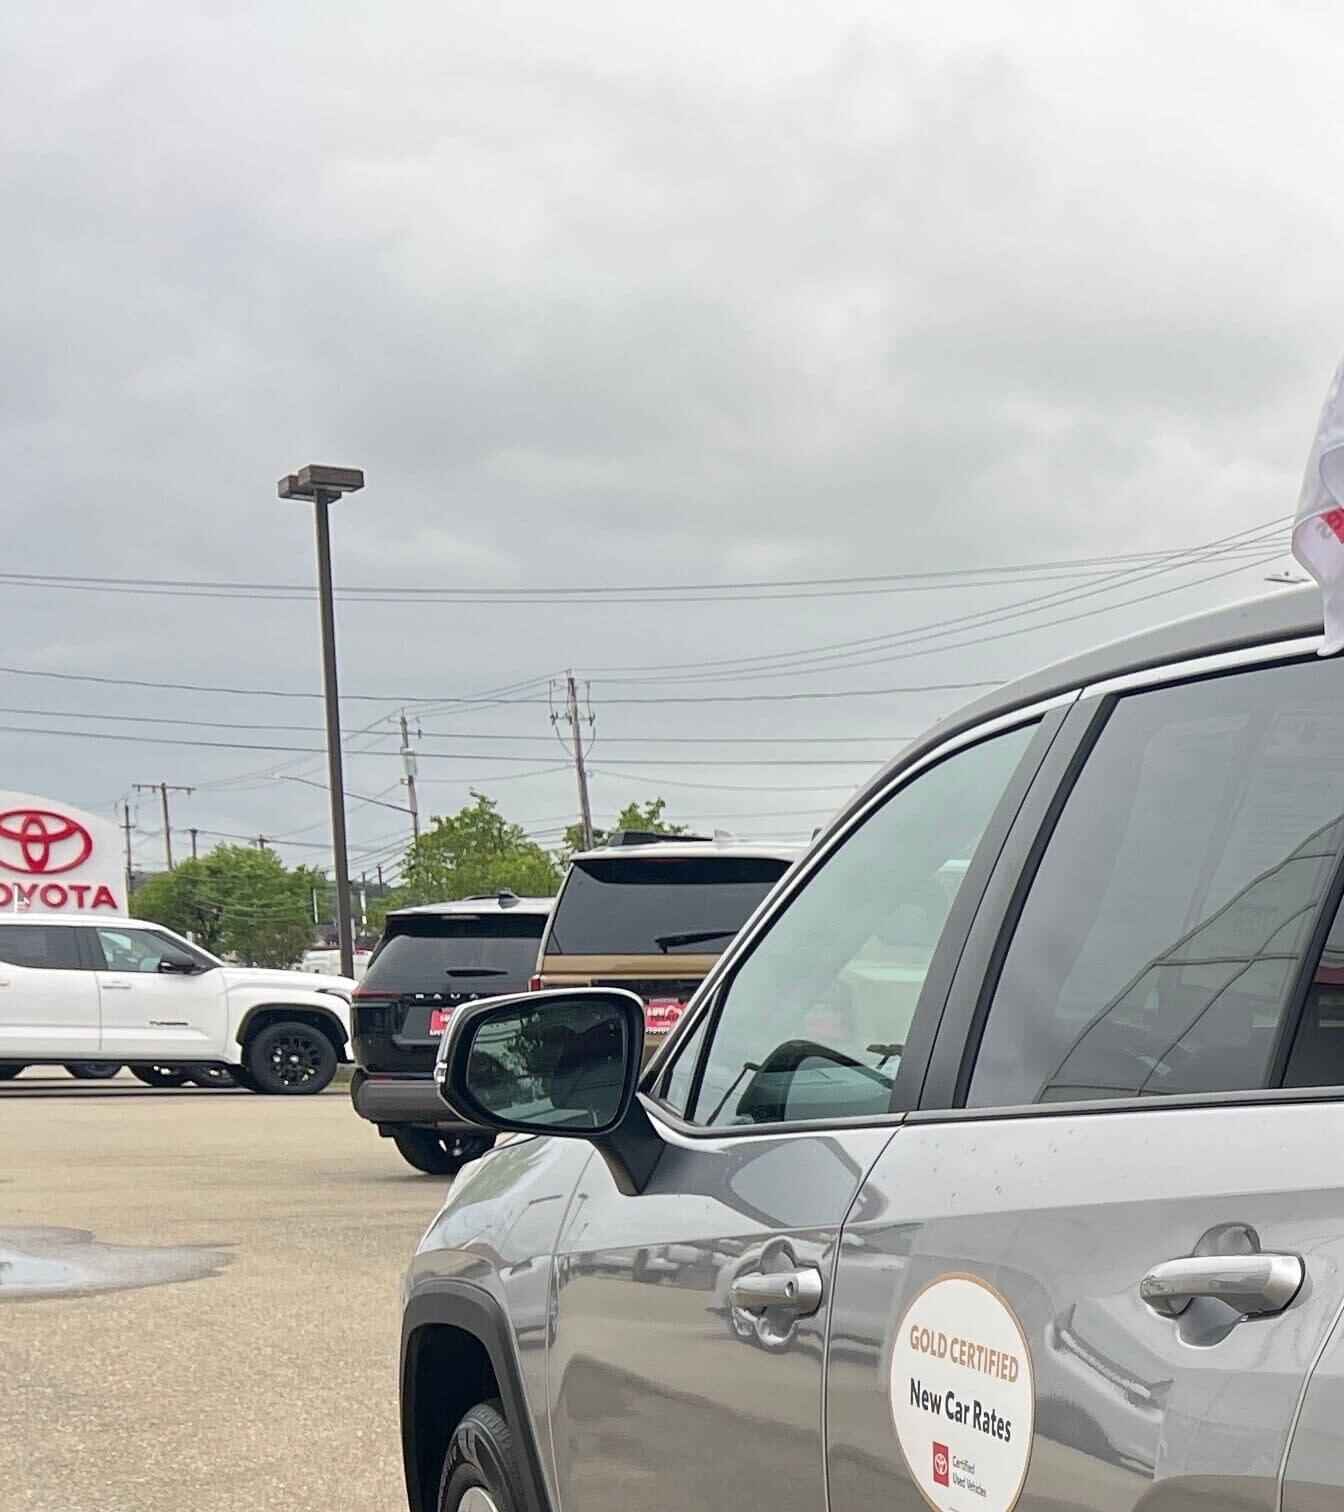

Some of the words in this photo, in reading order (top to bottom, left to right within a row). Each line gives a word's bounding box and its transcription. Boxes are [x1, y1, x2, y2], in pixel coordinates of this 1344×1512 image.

[910, 1324, 947, 1359] GOLD
[950, 1337, 1019, 1384] CERTIFIED
[910, 1377, 942, 1417] New
[945, 1390, 970, 1426] Car
[972, 1399, 1012, 1443] Rates
